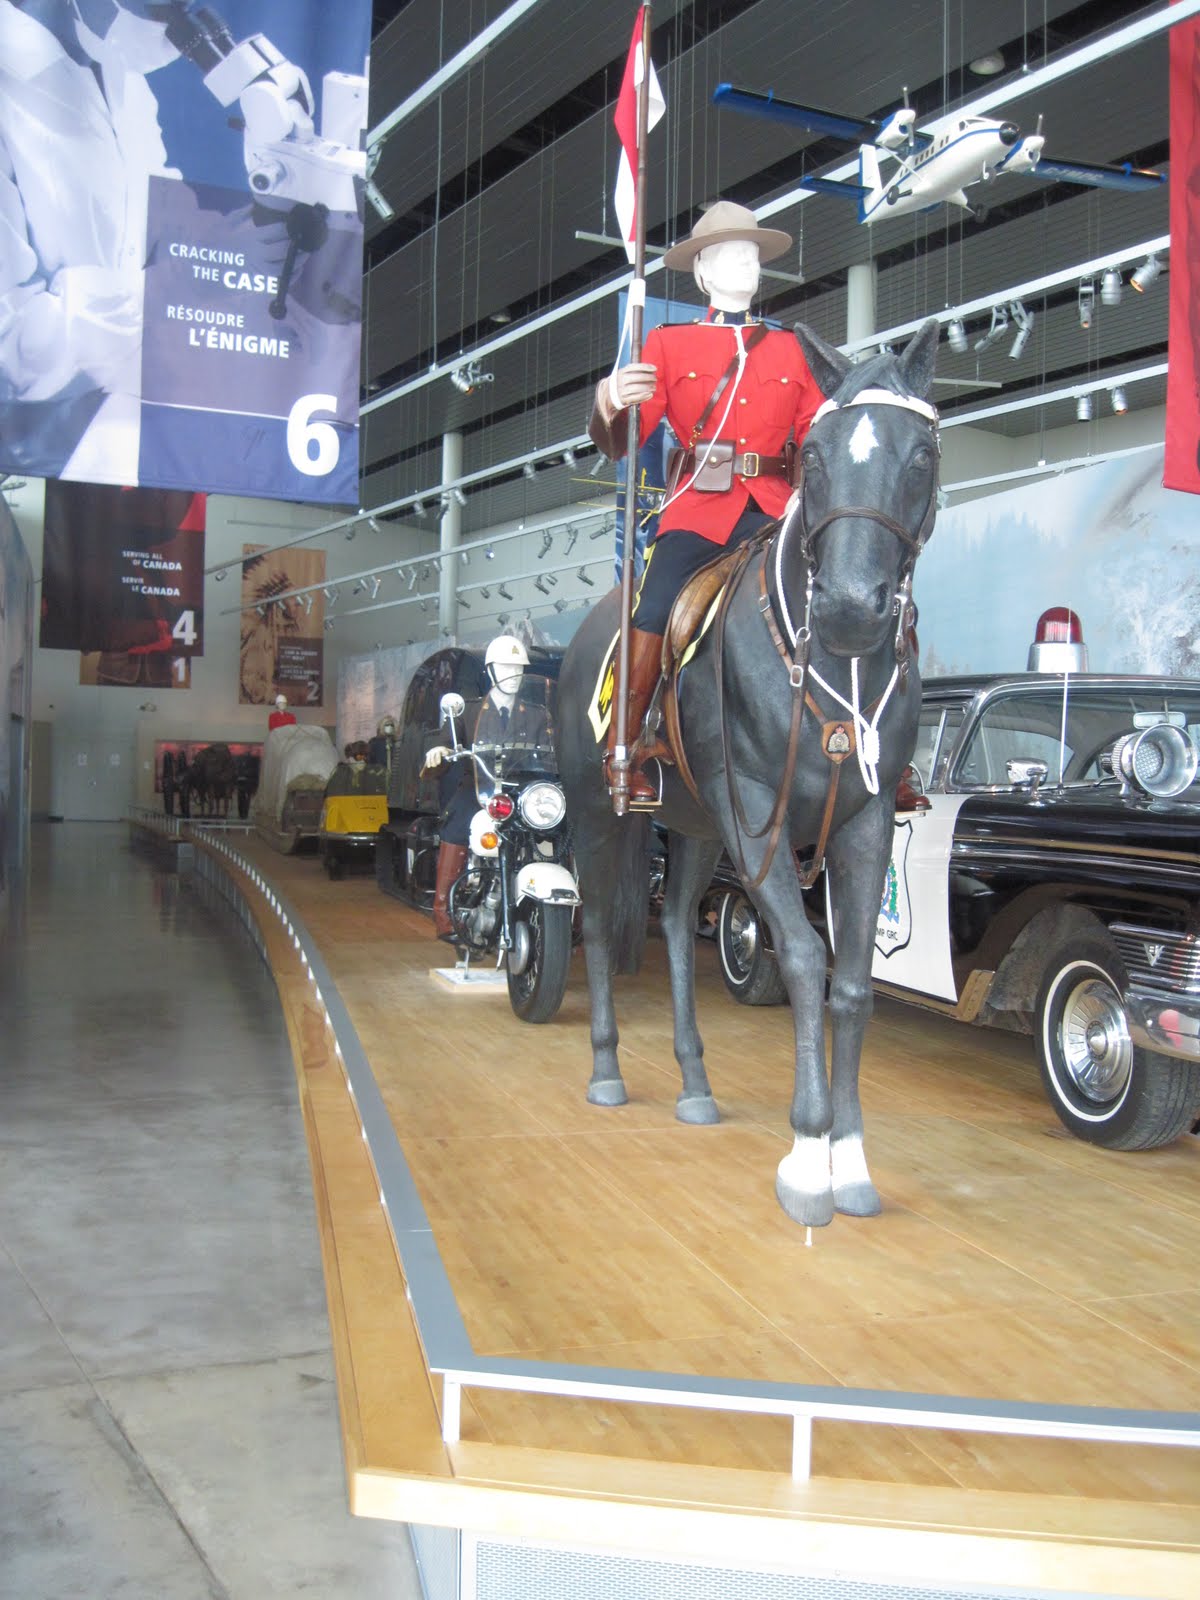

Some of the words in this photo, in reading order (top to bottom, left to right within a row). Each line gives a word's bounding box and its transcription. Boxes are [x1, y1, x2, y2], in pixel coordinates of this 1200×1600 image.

[169, 242, 245, 267] CRACKING
[193, 265, 220, 282] THE
[223, 271, 279, 294] CASE
[167, 304, 245, 328] RÉSOUDRE
[189, 327, 290, 359] L'ÉNIGME
[286, 393, 340, 476] 6
[122, 550, 150, 559] SERVING
[143, 560, 182, 571] CANADA
[121, 576, 144, 584] SERVIR
[141, 585, 180, 596] CANADA
[172, 610, 197, 646] 4
[173, 657, 186, 682] 1
[307, 681, 319, 701] 2
